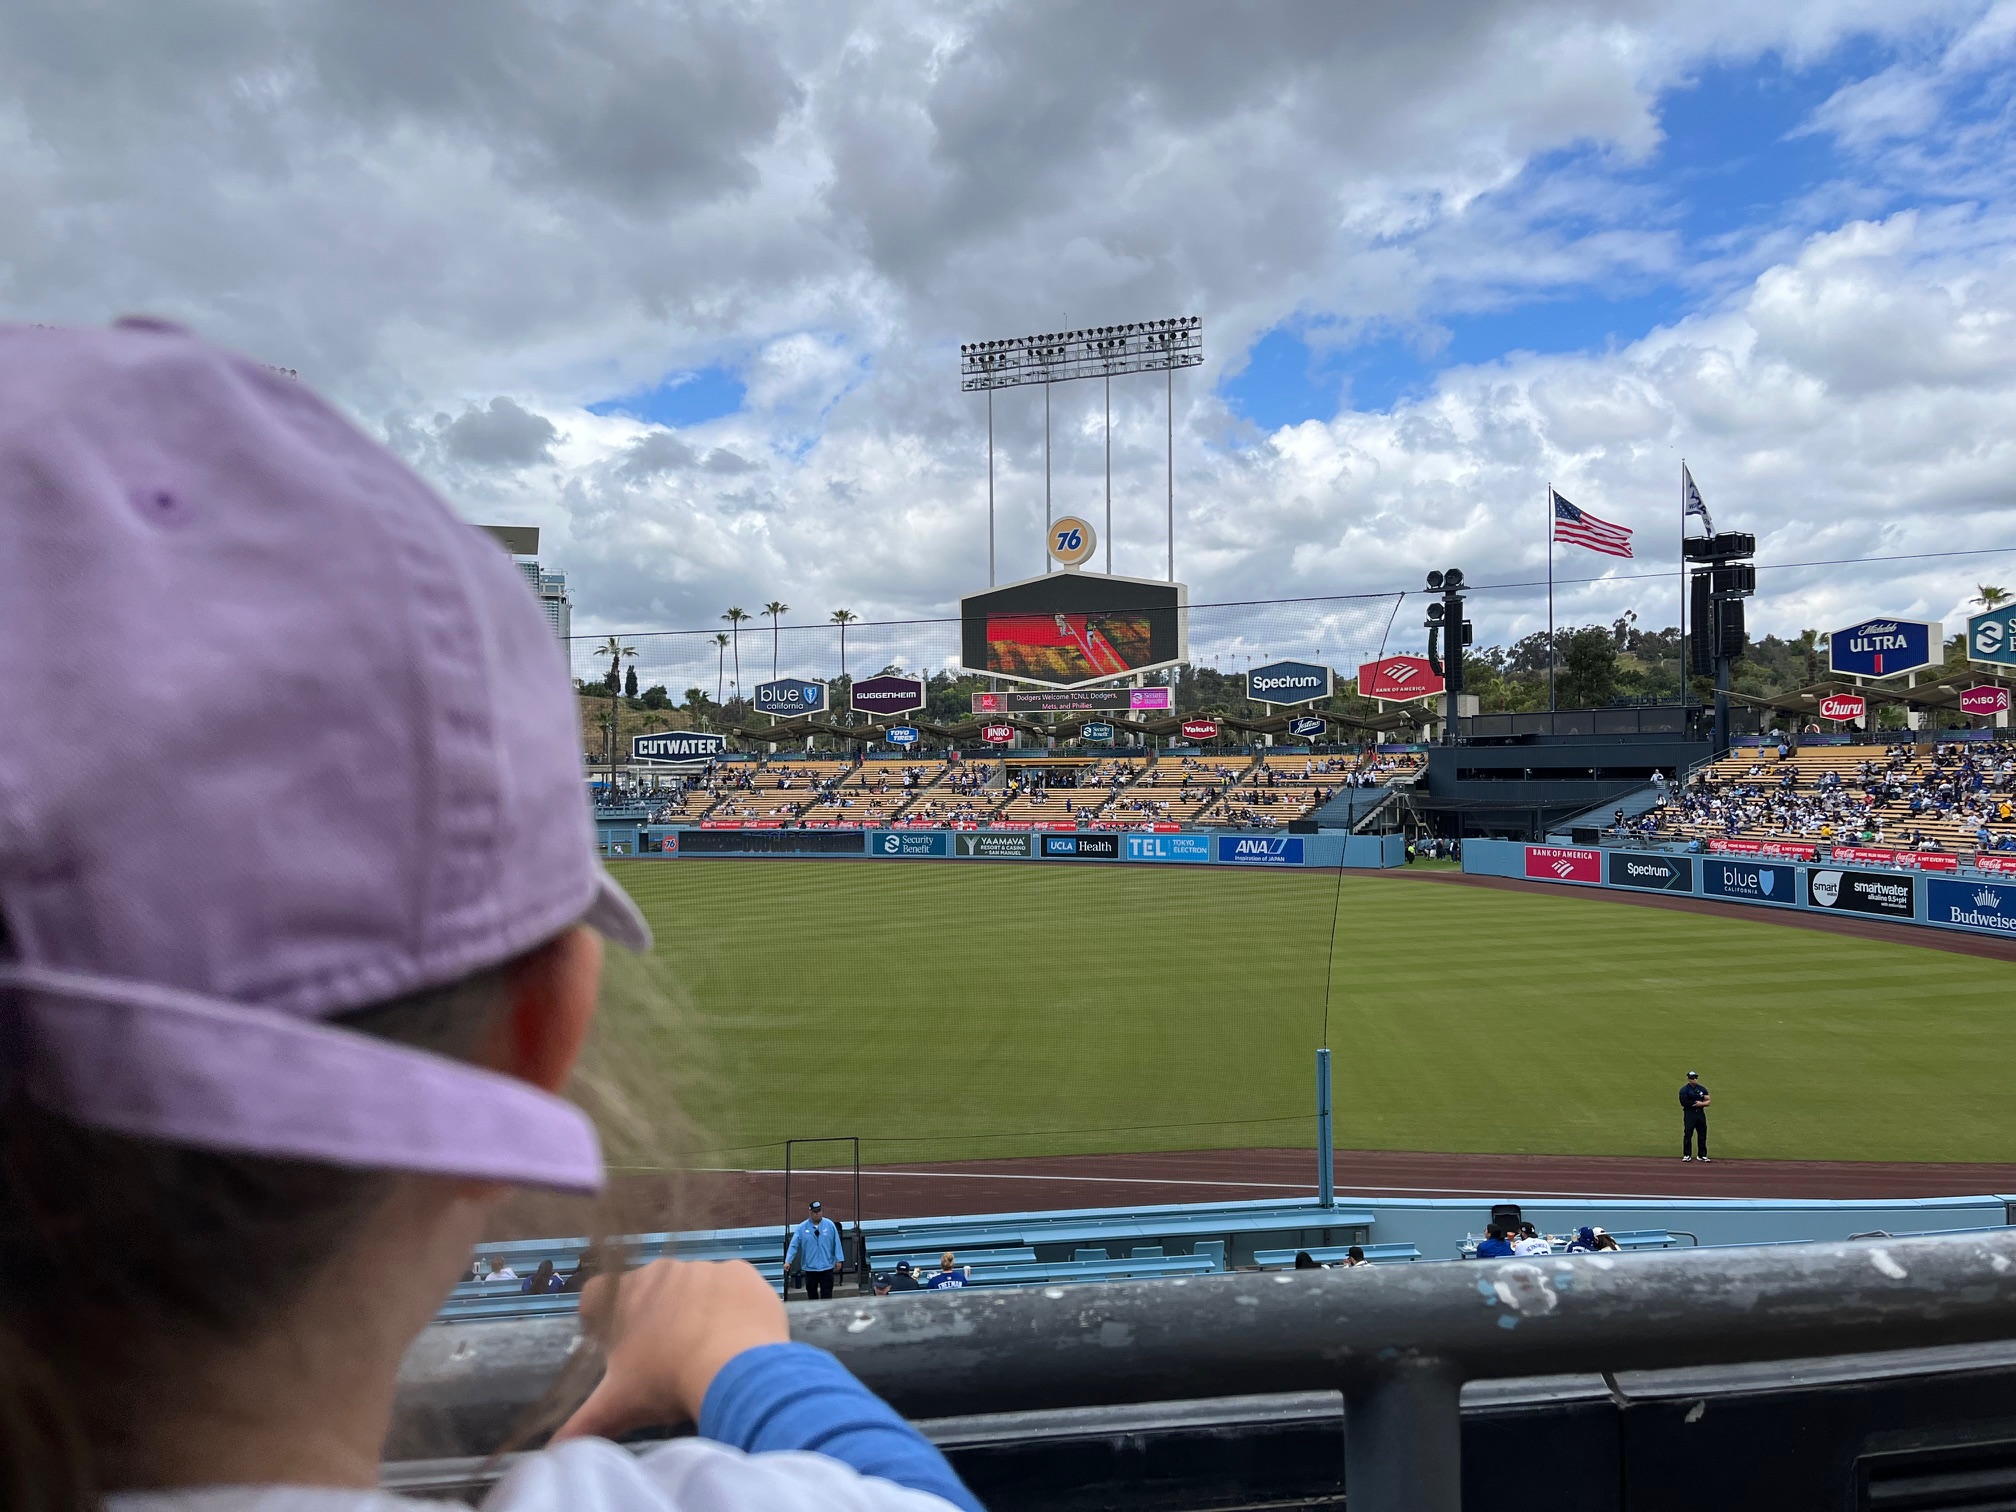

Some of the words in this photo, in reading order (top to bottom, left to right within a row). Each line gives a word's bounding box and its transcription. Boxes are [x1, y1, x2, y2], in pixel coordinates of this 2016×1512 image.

[1056, 528, 1082, 551] 76
[1850, 634, 1908, 653] ULTRA
[1253, 675, 1317, 692] Spectrum
[760, 686, 799, 702] blue
[856, 691, 917, 700] GUGGENHEIM
[1016, 694, 1041, 703] Dodgers
[766, 702, 804, 710] california
[1962, 696, 1994, 706] DAISO
[1822, 700, 1863, 716] Churu
[987, 728, 1010, 739] JINRO
[638, 740, 717, 755] CUTWATER
[665, 838, 676, 849] 76
[902, 836, 934, 846] Security
[1050, 841, 1073, 850] UCLA
[1078, 841, 1112, 852] Health
[1172, 839, 1194, 847] TOKYO
[903, 845, 930, 854] Benefit
[1129, 838, 1167, 857] TEL
[1173, 846, 1207, 854] ELECTRON
[1235, 840, 1269, 854] ANA
[1532, 848, 1551, 857] BANK
[1552, 850, 1561, 858] OF
[1561, 851, 1593, 860] AMERICA
[1627, 862, 1669, 878] Spectrum
[1723, 866, 1758, 888] blue
[1724, 886, 1758, 894] CALIFORNIA
[1813, 882, 1838, 893] smart
[1854, 882, 1908, 897] smartwater
[1867, 894, 1887, 902] alkaline
